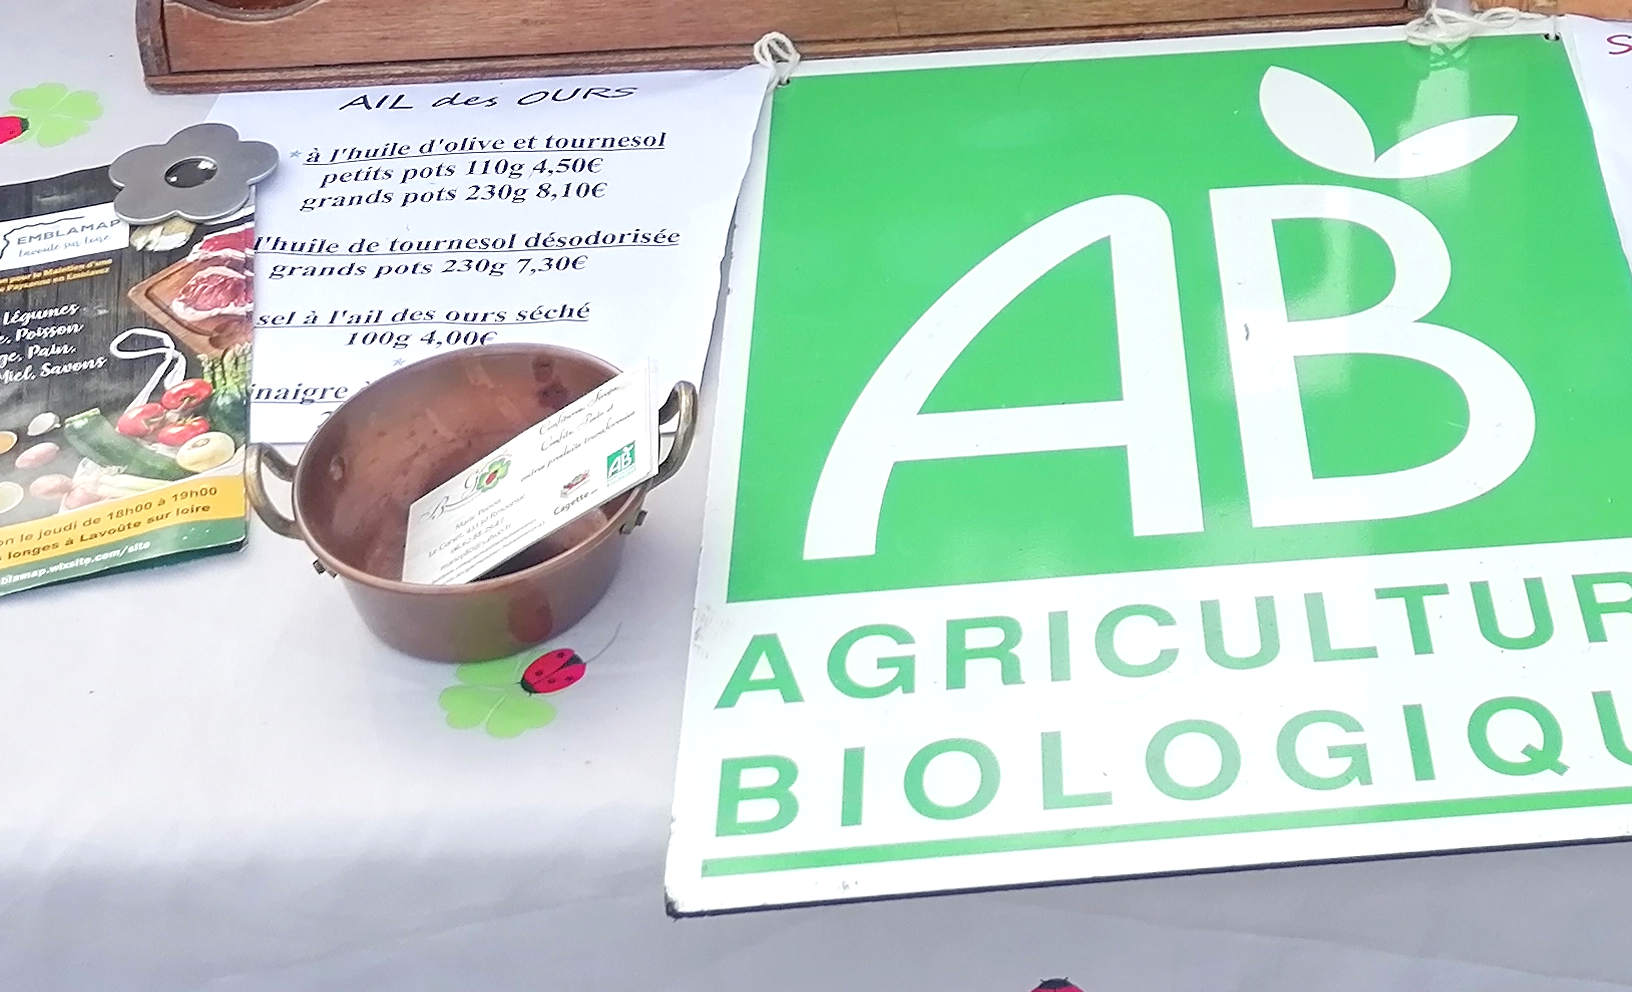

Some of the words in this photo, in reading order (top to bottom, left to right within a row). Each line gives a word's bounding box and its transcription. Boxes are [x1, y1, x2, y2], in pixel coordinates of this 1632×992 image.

[339, 94, 414, 110] AIL
[431, 92, 499, 107] des
[517, 87, 639, 106] OURS
[306, 147, 320, 163] à
[330, 142, 411, 162] l'huile
[419, 136, 505, 155] d'olive
[514, 136, 538, 150] et
[546, 132, 667, 150] tournesol
[320, 166, 395, 189] petits
[400, 163, 456, 184] pots
[467, 158, 526, 180] 110g
[533, 157, 604, 177] 4,50€
[299, 189, 395, 212] grands
[401, 185, 458, 207] pots
[465, 184, 529, 204] 230g
[535, 182, 608, 202] 8,10€
[17, 219, 121, 246] EMBLAMAP
[254, 236, 340, 254] l'huile
[349, 237, 380, 254] de
[389, 233, 516, 253] tournesol
[524, 228, 681, 249] désodorisée
[269, 262, 368, 280] grands
[374, 261, 434, 280] pots
[441, 258, 508, 277] 230g
[516, 255, 589, 276] 7,30€
[3, 302, 80, 327] Légumes
[256, 311, 296, 326] sel
[303, 310, 319, 325] à
[329, 309, 384, 325] l'ail
[391, 308, 436, 323] des
[445, 310, 507, 323] ours
[516, 302, 591, 322] séché
[15, 322, 84, 342] Poisson
[347, 331, 413, 350] 100g
[420, 329, 498, 348] 4,00€
[40, 357, 108, 378] Savons
[803, 184, 1537, 563] AB
[251, 382, 348, 405] inaigre
[36, 519, 78, 541] jeudi
[82, 517, 102, 527] de
[157, 498, 166, 507] à
[172, 486, 218, 502] 19h00
[79, 520, 142, 543] Lavoûte
[147, 511, 172, 524] sur
[175, 503, 211, 517] loire
